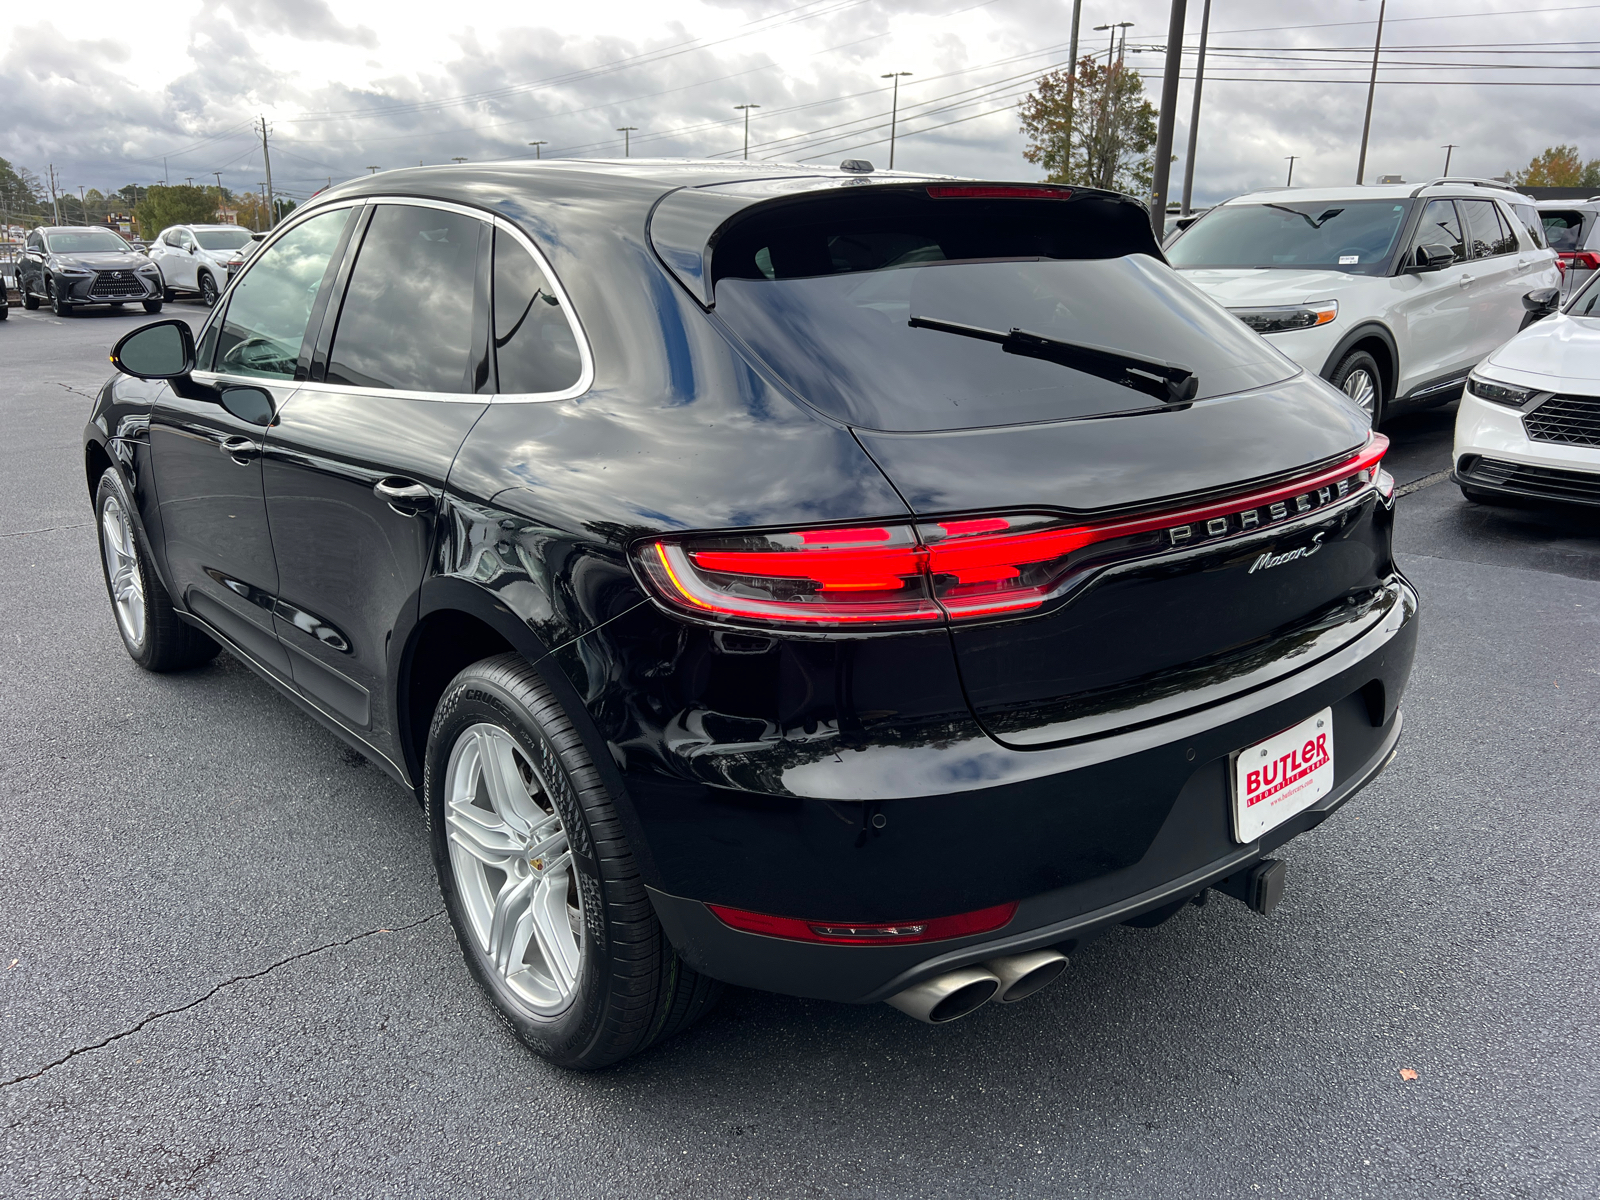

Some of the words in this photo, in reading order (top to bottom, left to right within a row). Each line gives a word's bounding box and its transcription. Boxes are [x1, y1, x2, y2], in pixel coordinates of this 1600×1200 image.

[1169, 479, 1349, 545] PORSCHE
[1248, 546, 1306, 574] Macan
[1304, 531, 1325, 557] S
[1247, 772, 1300, 807] AUTOMOTIVE
[1306, 755, 1329, 774] GROUP
[1270, 778, 1314, 807] www.butlercars.com
